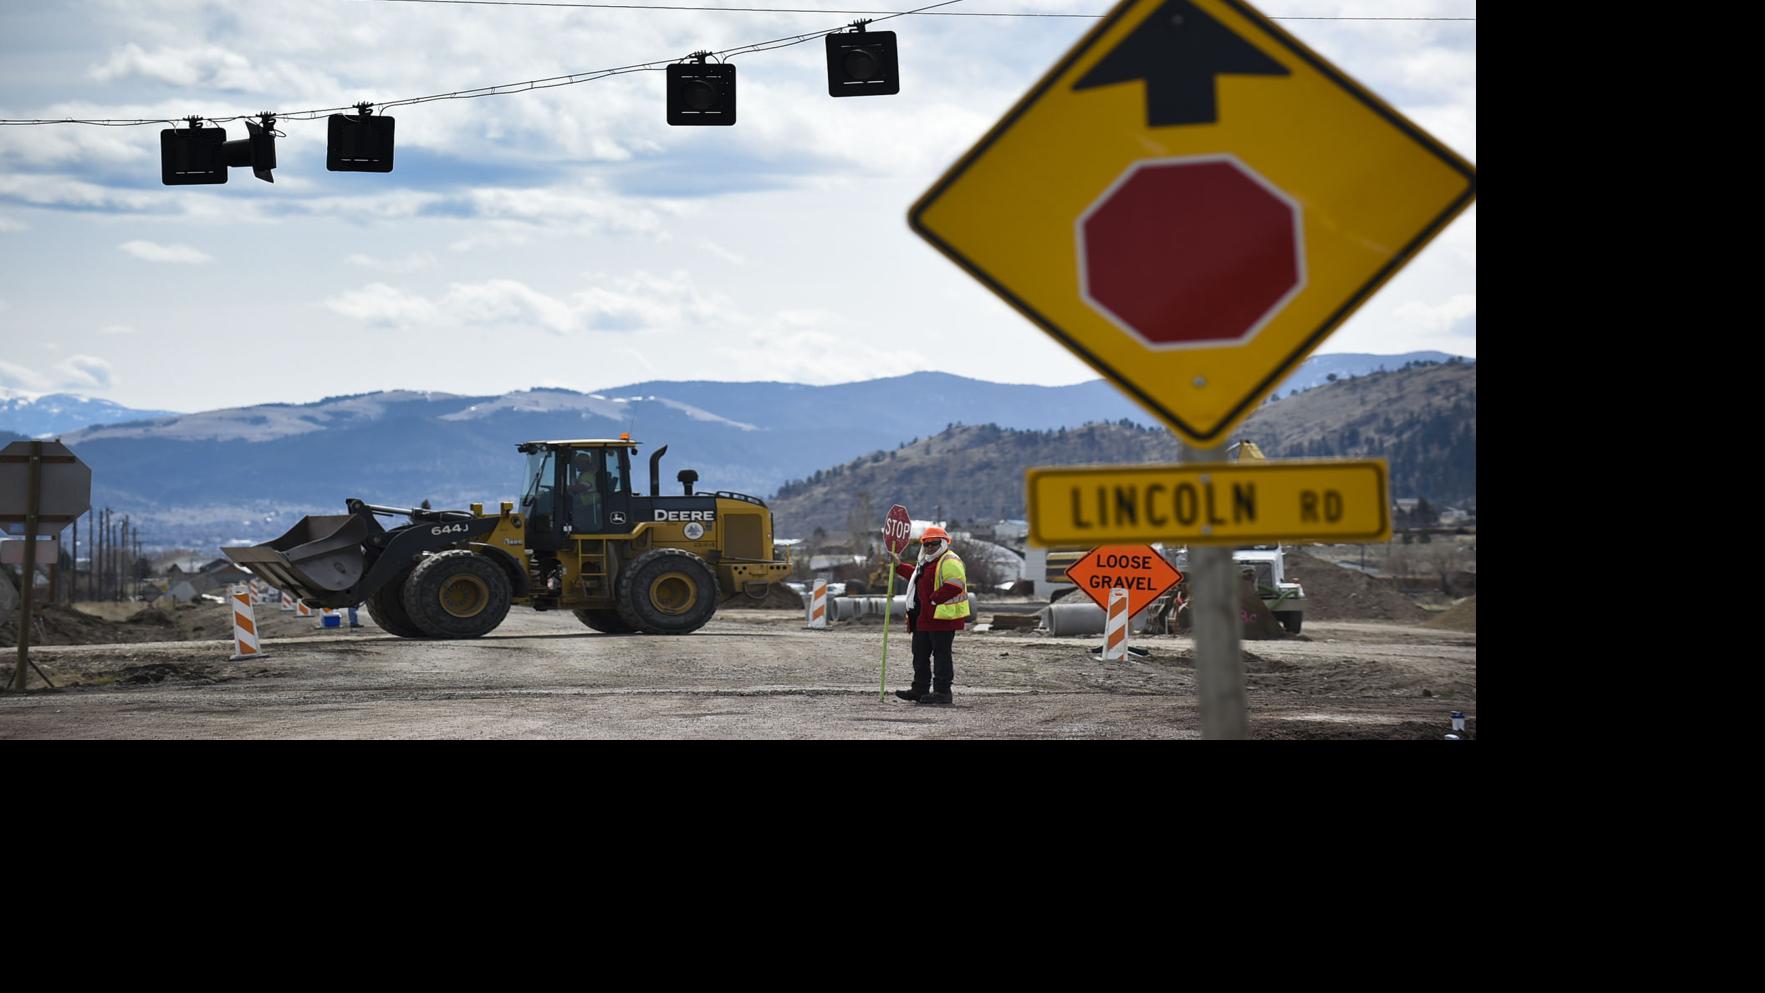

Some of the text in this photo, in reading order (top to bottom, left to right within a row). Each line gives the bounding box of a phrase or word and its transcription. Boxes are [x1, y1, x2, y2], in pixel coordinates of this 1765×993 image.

[1071, 481, 1344, 529] LINCOLN RD
[654, 509, 714, 521] DEERE
[431, 524, 469, 535] 644J
[885, 518, 910, 539] STOP
[1096, 554, 1152, 569] LOOSE
[1089, 575, 1157, 591] GRAVEL
